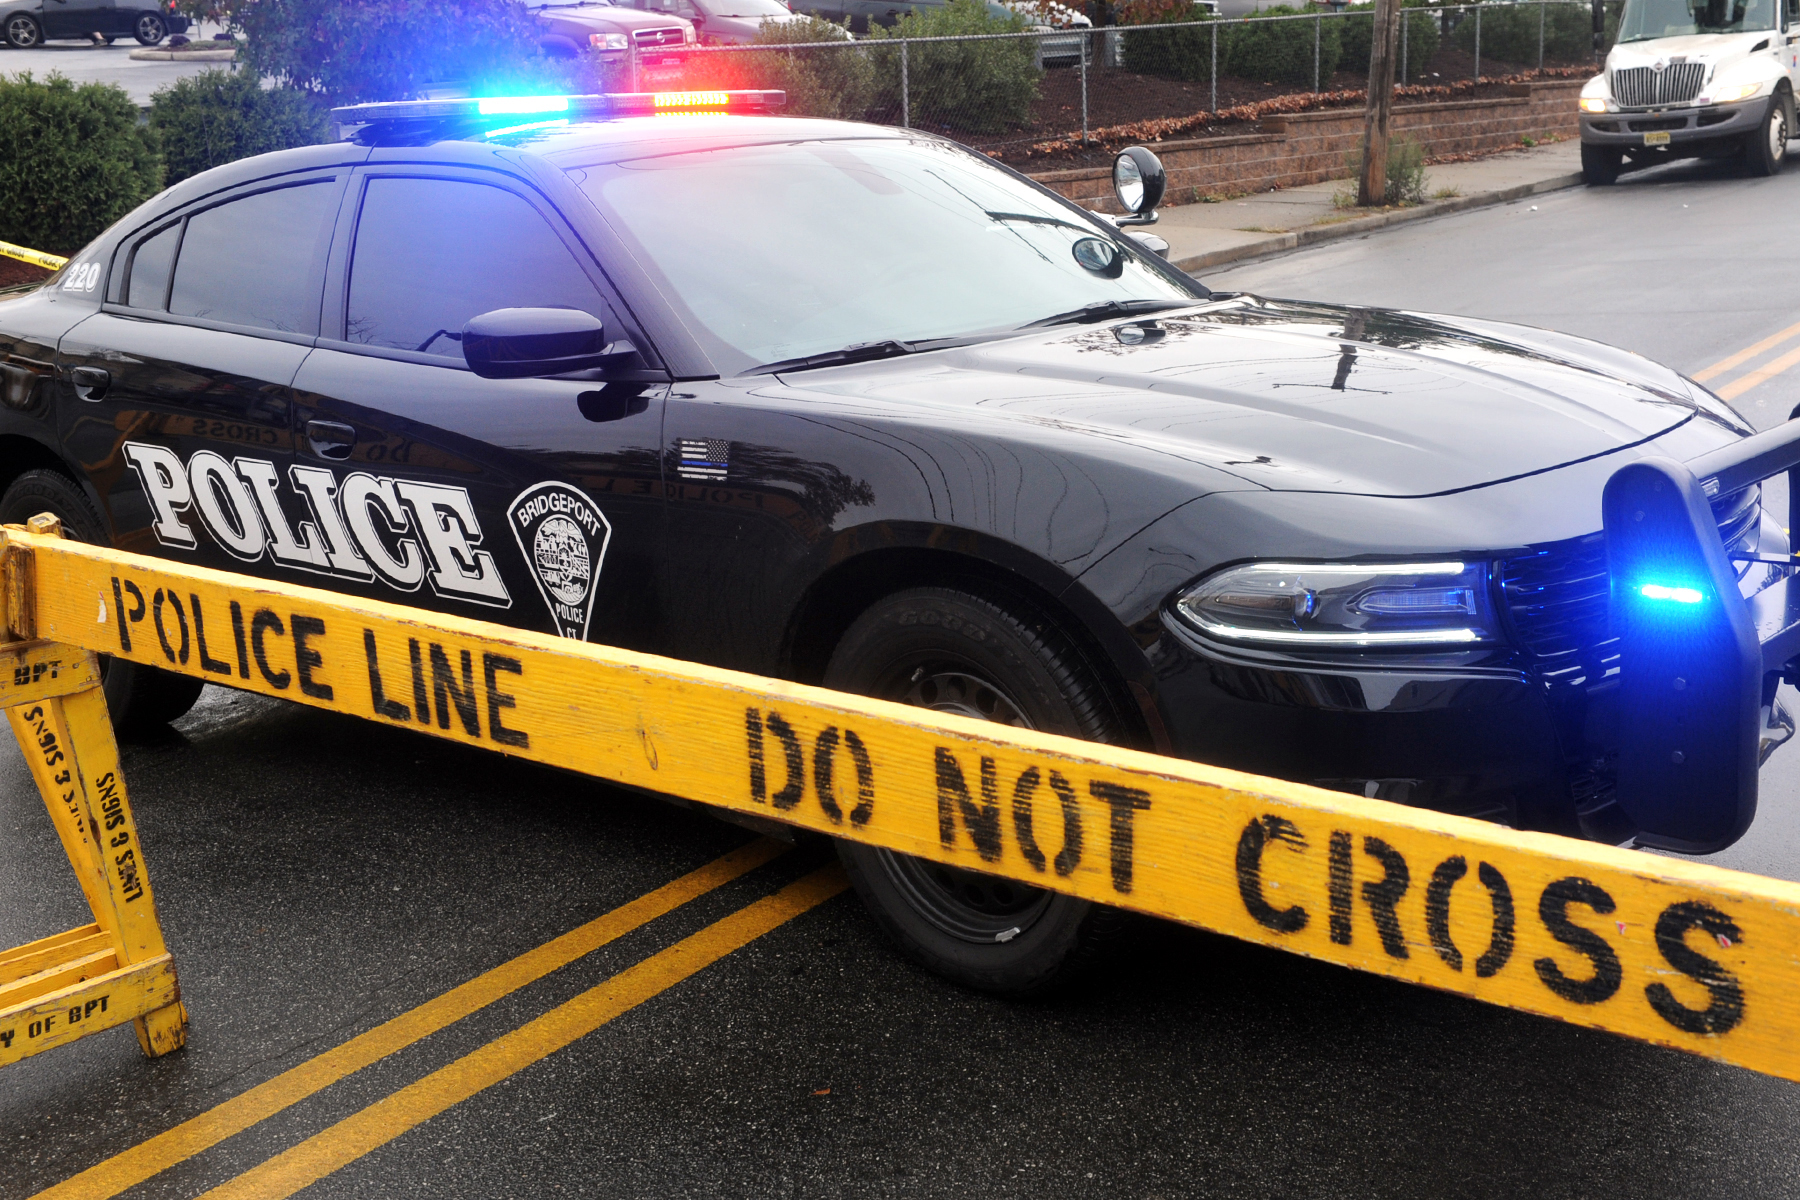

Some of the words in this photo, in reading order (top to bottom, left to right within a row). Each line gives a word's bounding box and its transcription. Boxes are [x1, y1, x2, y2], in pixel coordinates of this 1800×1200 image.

[62, 262, 101, 292] 220
[122, 441, 513, 609] POLICE
[517, 492, 601, 537] BRIDGEPORT
[555, 602, 585, 624] POLICE
[24, 706, 65, 766] SIGNS
[96, 772, 126, 831] SIGNS
[111, 576, 334, 701] POLICE
[363, 628, 530, 748] LINE
[745, 707, 875, 830] DO
[935, 745, 1151, 894] NOT
[1236, 813, 1746, 1037] CROSS
[28, 1015, 56, 1038] OF
[69, 994, 110, 1025] BPT
